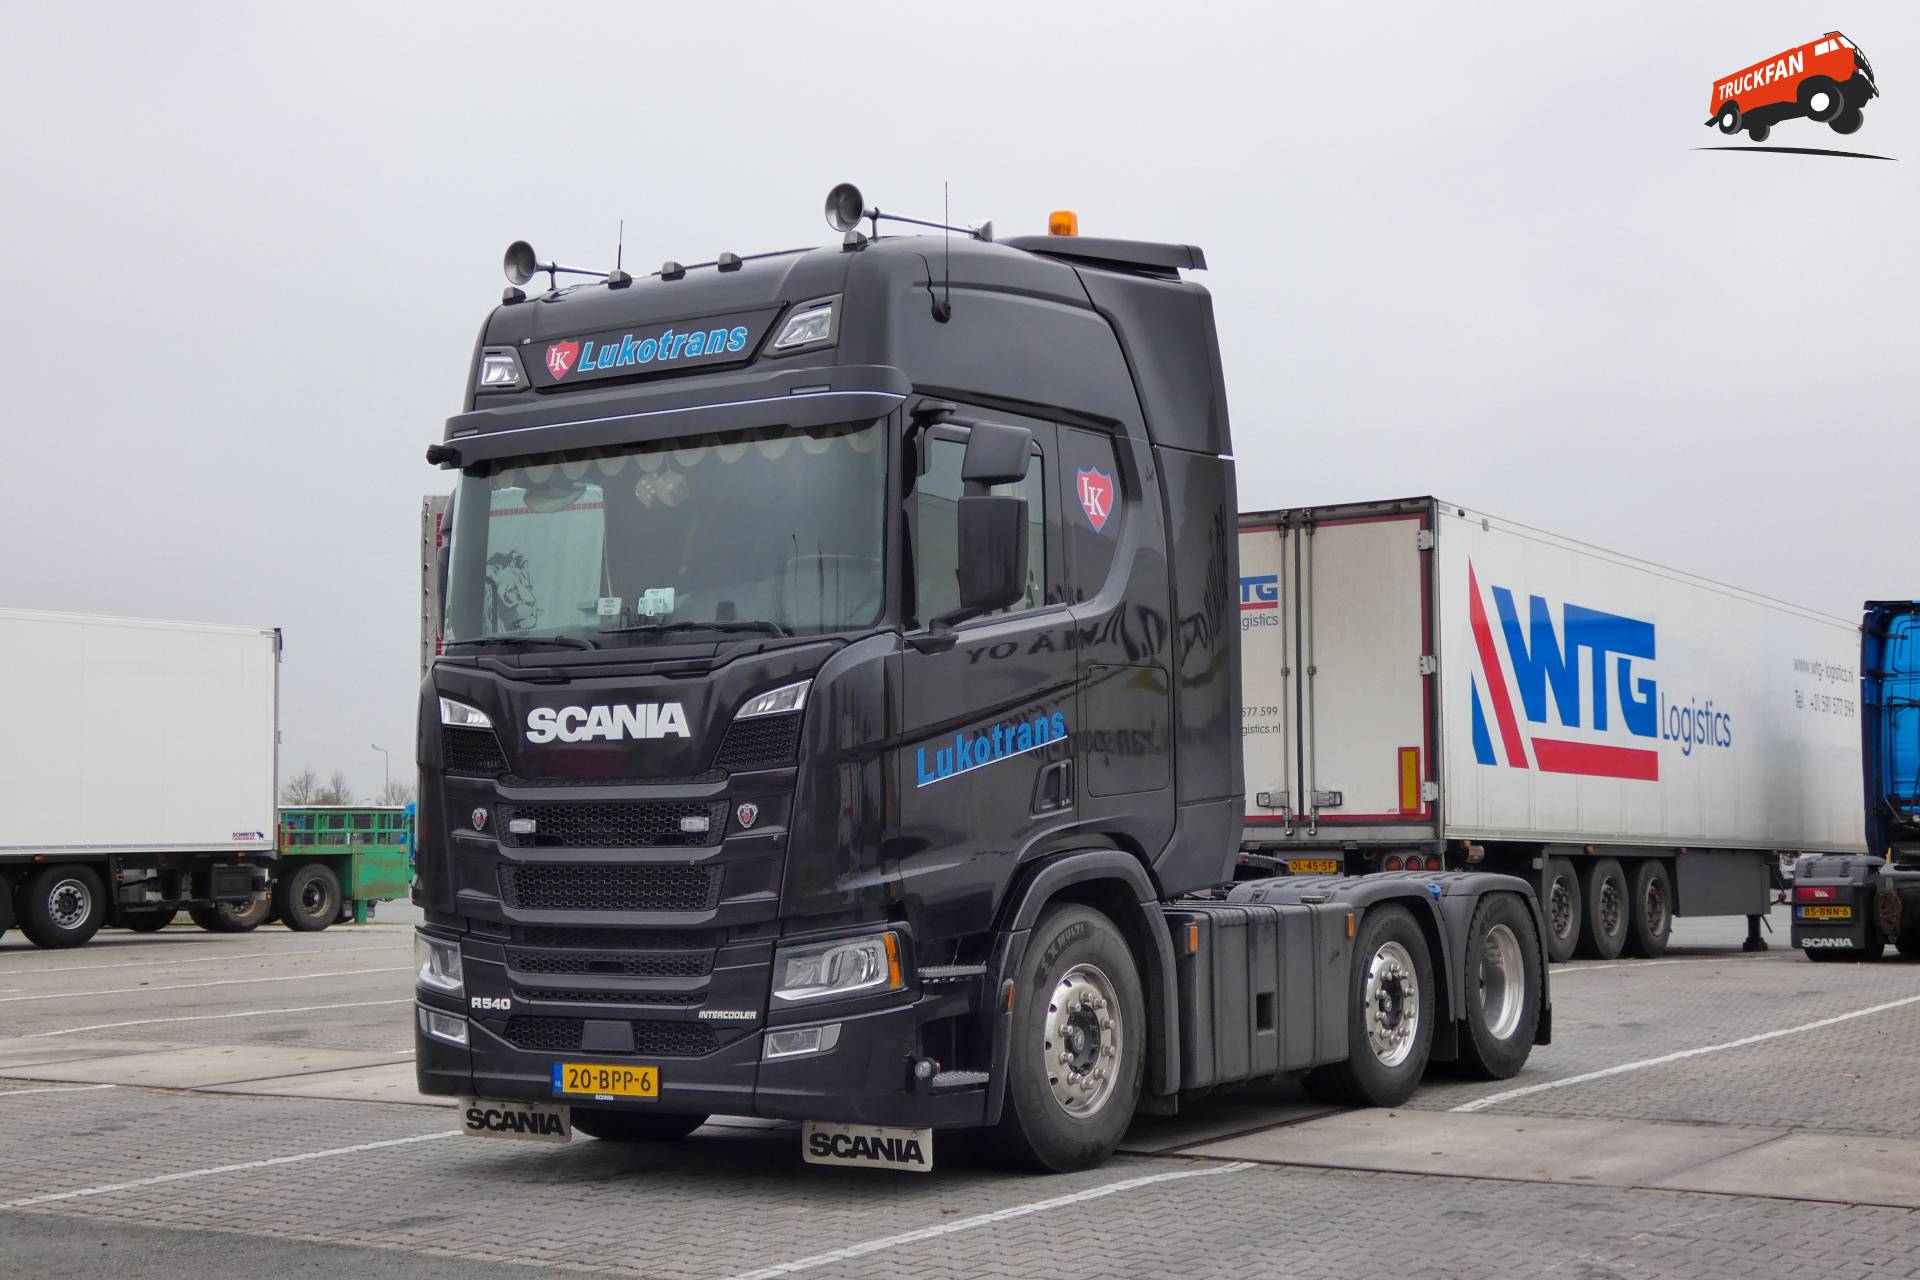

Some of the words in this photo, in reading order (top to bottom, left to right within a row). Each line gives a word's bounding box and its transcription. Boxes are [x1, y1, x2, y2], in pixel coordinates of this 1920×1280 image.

[577, 327, 747, 371] Lukotrans
[1240, 575, 1278, 602] TG
[1241, 613, 1279, 631] gistics
[1491, 585, 1658, 739] WTG
[526, 702, 691, 744] SCANIA
[1260, 706, 1278, 717] 599
[1662, 691, 1732, 757] Logistics
[1241, 723, 1281, 737] gistics.nl
[917, 711, 1066, 785] Lukotrans
[1801, 937, 1853, 947] SCANIA
[471, 997, 511, 1010] R540
[699, 1010, 757, 1020] INTERCOOLER
[568, 1068, 651, 1092] 20-BPP-6
[466, 1108, 566, 1136] SCANIA
[809, 1132, 925, 1165] SCANIA
